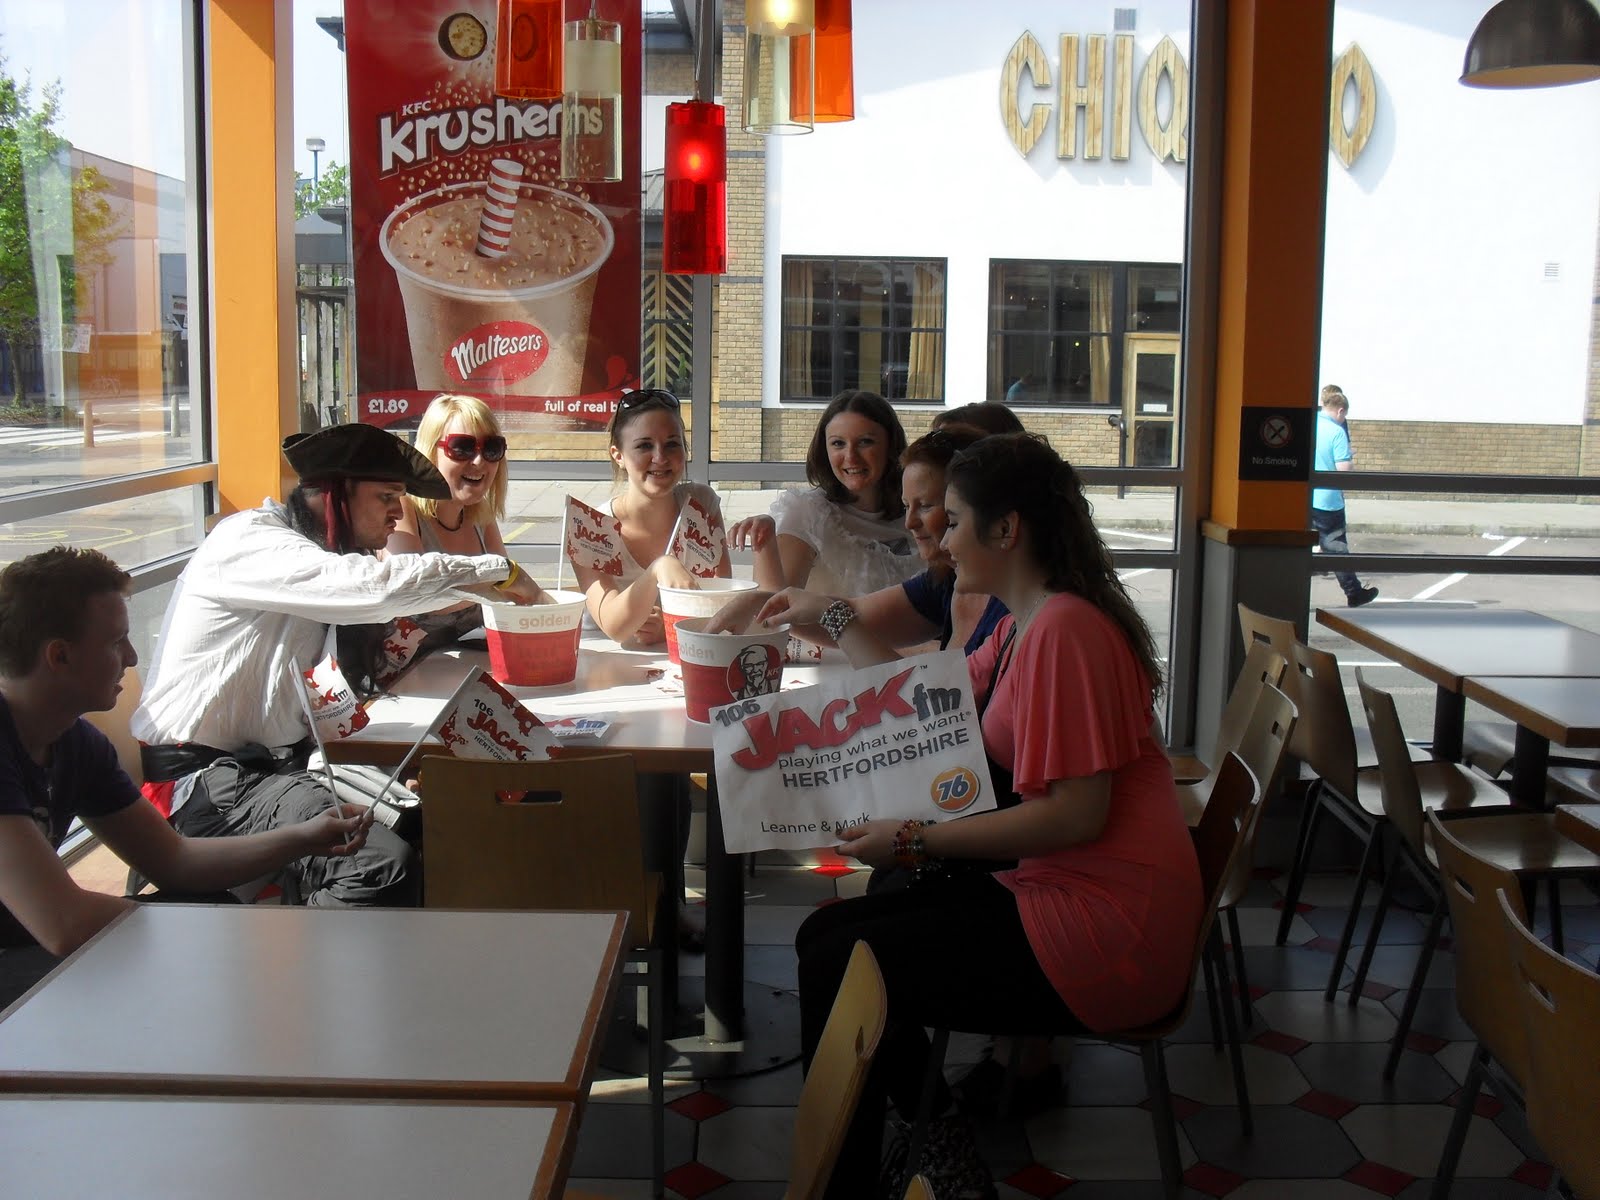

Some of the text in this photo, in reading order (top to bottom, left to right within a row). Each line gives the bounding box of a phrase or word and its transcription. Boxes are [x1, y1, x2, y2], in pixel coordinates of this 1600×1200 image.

[402, 101, 431, 116] KFC
[451, 333, 542, 381] Maltesers
[368, 399, 408, 414] £1.89
[545, 400, 564, 412] full
[567, 401, 581, 412] of
[583, 401, 607, 413] real
[1252, 456, 1297, 468] No Smoking
[574, 525, 608, 542] JACK
[518, 614, 571, 629] golden
[680, 642, 715, 660] olden
[474, 698, 494, 716] 106
[715, 665, 962, 770] 106 JACK fm
[466, 711, 532, 760] JACK
[474, 735, 506, 761] HERTFOR
[778, 749, 841, 770] playing
[846, 734, 888, 756] what
[892, 727, 919, 742] we
[782, 728, 970, 788] HERTFORDSHIRE
[935, 774, 970, 802] 76
[760, 812, 870, 834] Leanne & Mark
